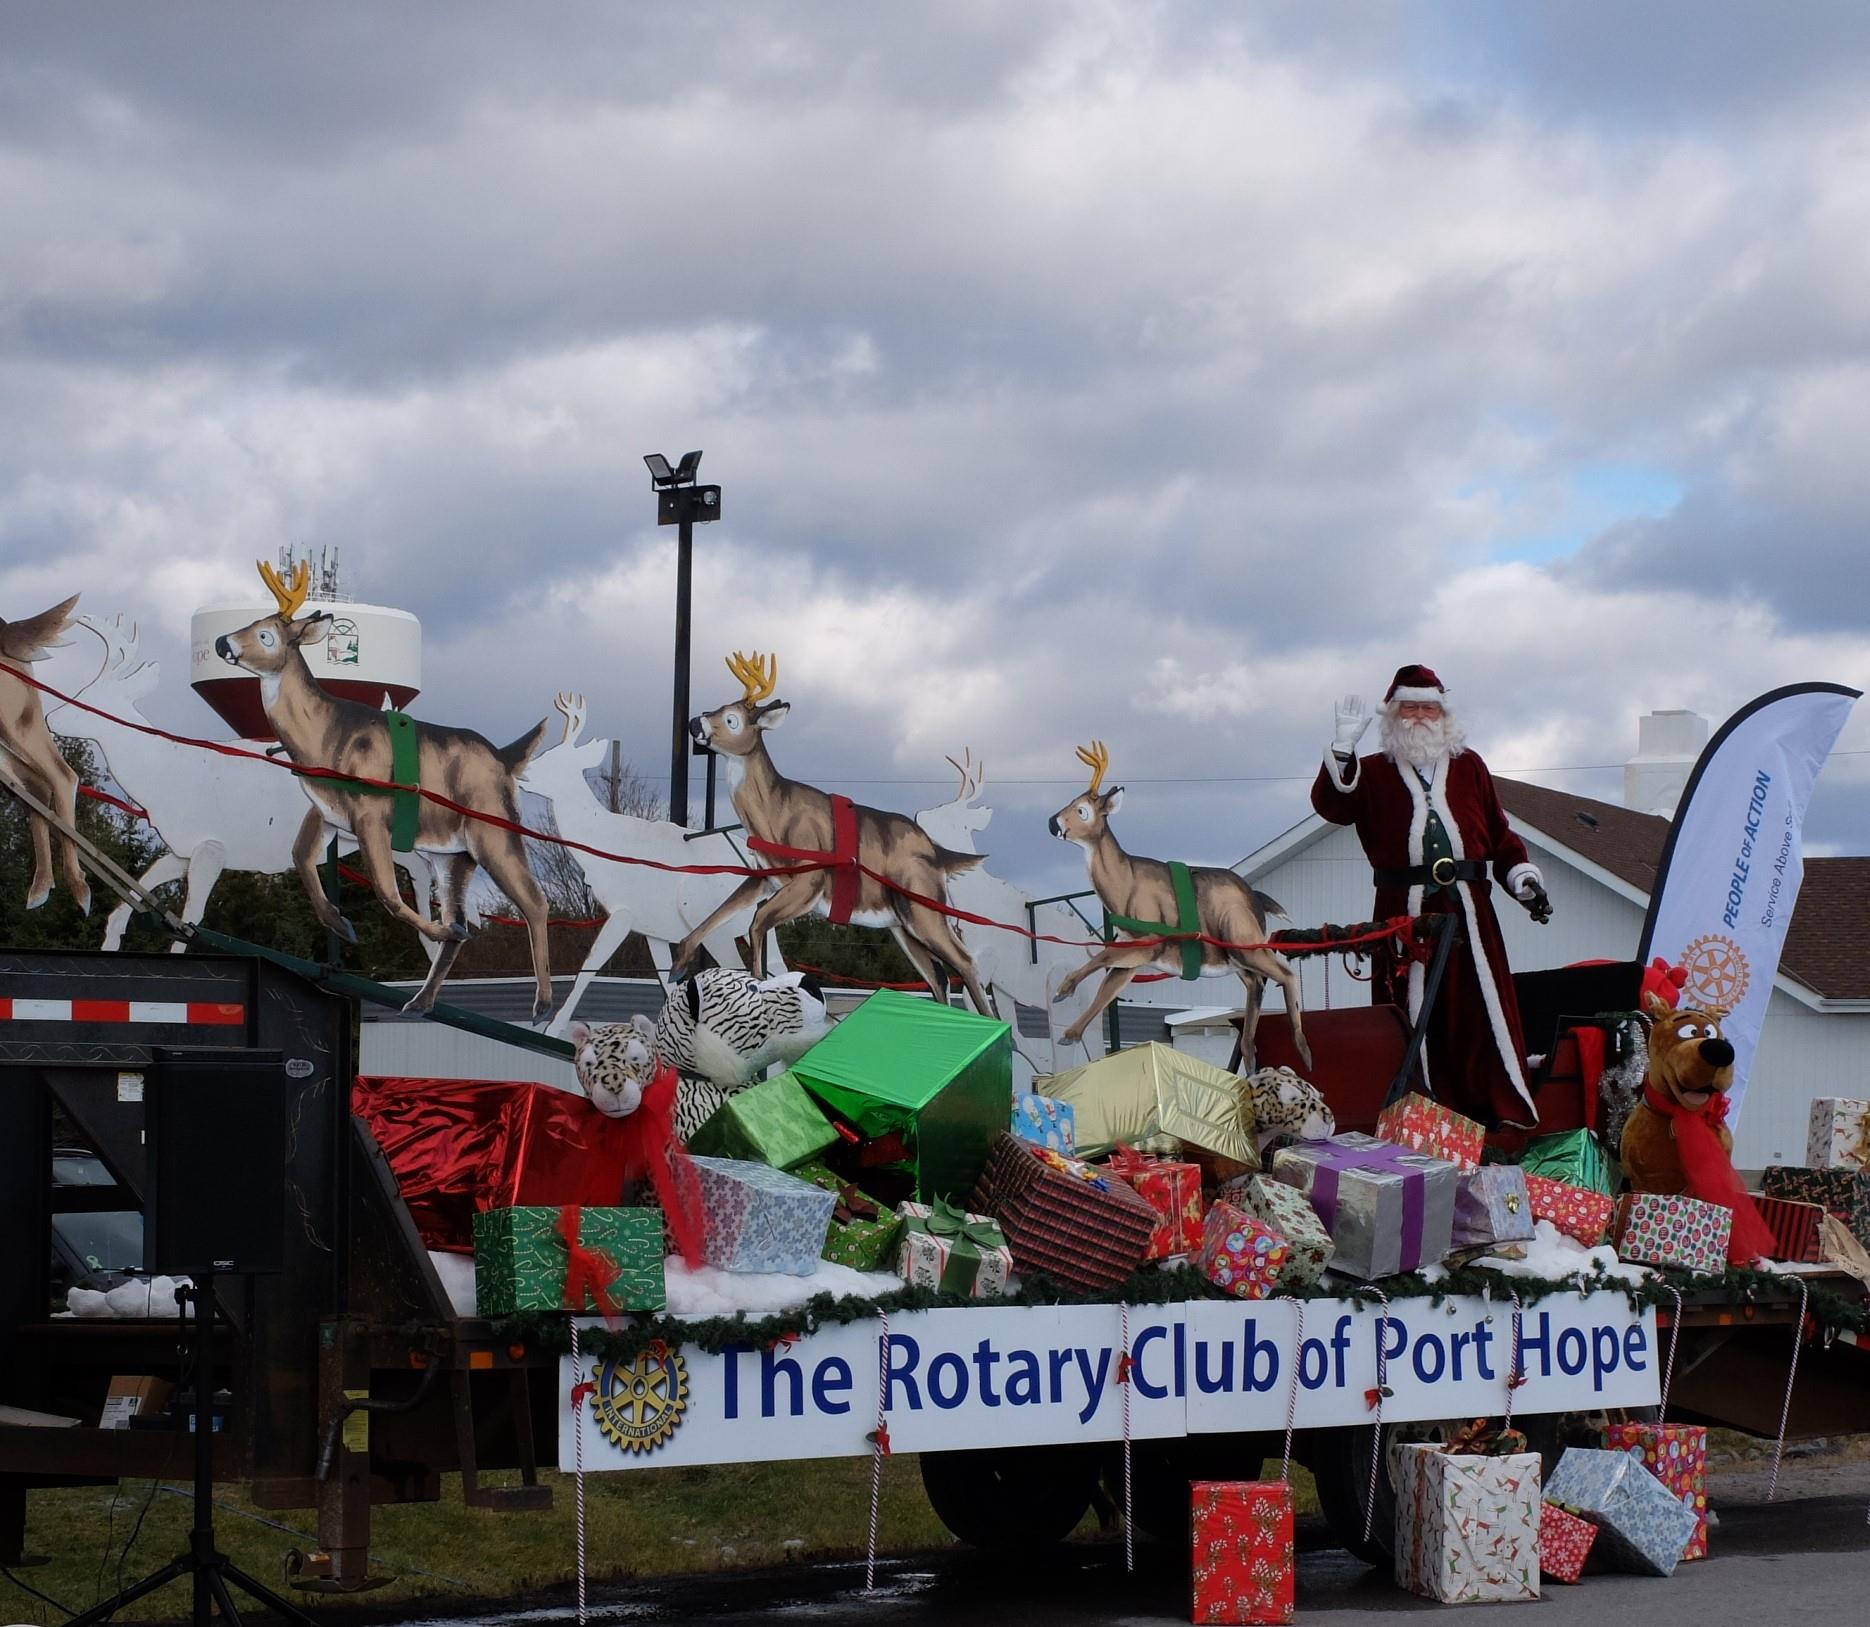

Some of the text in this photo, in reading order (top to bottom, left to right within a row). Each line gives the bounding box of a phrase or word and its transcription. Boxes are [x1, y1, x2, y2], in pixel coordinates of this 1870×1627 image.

[1743, 769, 1772, 842] ACTION
[1741, 838, 1752, 859] OF
[1761, 831, 1793, 929] Service Above
[1723, 858, 1750, 929] PEOPLE
[708, 1312, 1647, 1424] The Rotary Club of Port Hope
[605, 1407, 672, 1437] INTERNATIONAL
